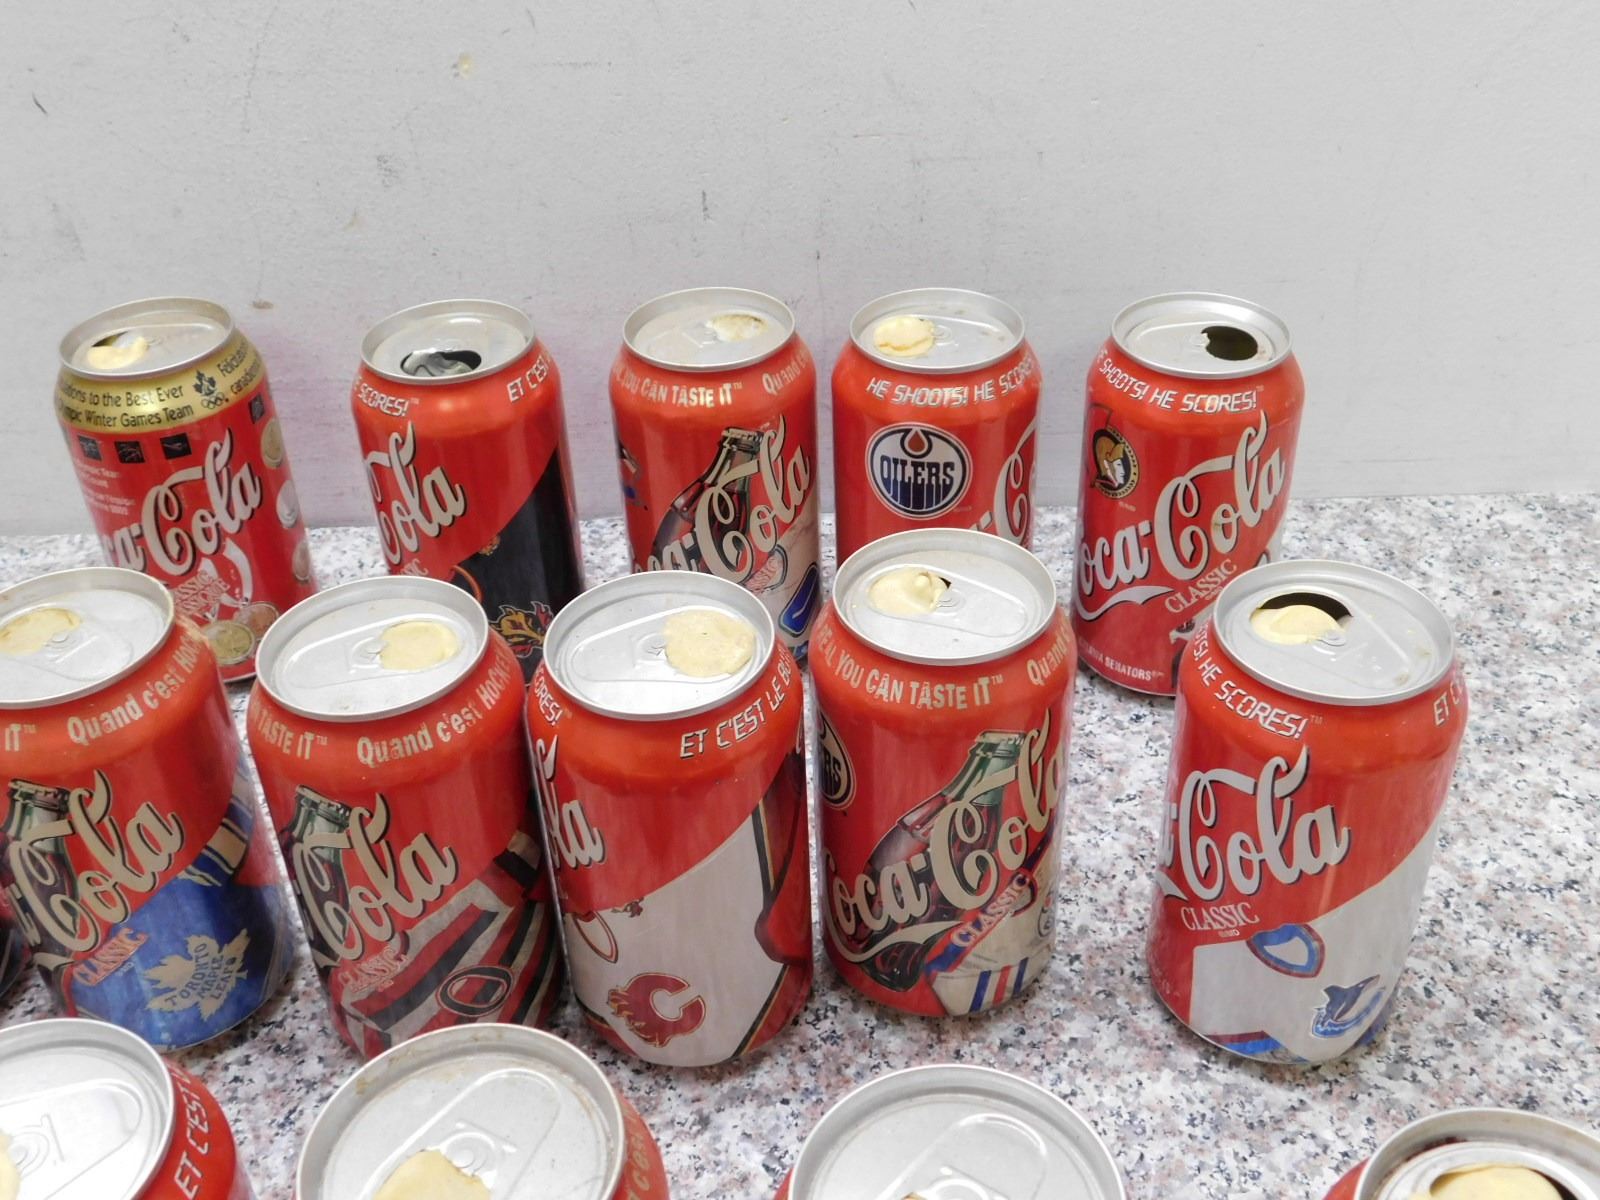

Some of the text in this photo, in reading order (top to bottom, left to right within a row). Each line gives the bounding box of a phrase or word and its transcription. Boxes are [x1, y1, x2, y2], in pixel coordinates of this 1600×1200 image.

[88, 389, 99, 405] to
[102, 391, 126, 406] the
[126, 391, 154, 406] Best
[157, 385, 184, 402] Ever
[507, 377, 524, 402] ET
[640, 377, 668, 404] CAN
[672, 385, 715, 408] TASTE
[866, 377, 891, 398] HE
[891, 384, 969, 407] SHOOTS!
[973, 380, 996, 402] HE
[1099, 357, 1150, 400] SHOOTS!
[1150, 387, 1179, 409] HE
[85, 409, 117, 427] Winter
[120, 411, 161, 427] Games
[164, 404, 194, 422] Team
[880, 454, 955, 512] OILERS
[1164, 558, 1237, 613] CLASSIC
[834, 651, 865, 689] YOU
[865, 668, 904, 703] CAN
[909, 681, 969, 711] TASTE
[1105, 656, 1152, 681] SENATORS
[1197, 656, 1223, 687] HE
[67, 692, 145, 746] Quand
[143, 667, 185, 710] c'est
[680, 727, 709, 759] ET
[716, 697, 765, 750] C'EST
[765, 676, 785, 711] LE
[1433, 690, 1450, 727] ET
[257, 708, 294, 755] TASTE
[357, 722, 434, 768] Quand
[437, 698, 483, 743] c'est
[950, 873, 1029, 948] CLASSIC
[1181, 902, 1260, 931] CLASSIC
[73, 928, 149, 987] CLASSIC
[164, 942, 207, 1006] TORONTO
[197, 954, 224, 999] MAPLE
[176, 1077, 209, 1155] C'EST
[174, 1150, 205, 1199] ET
